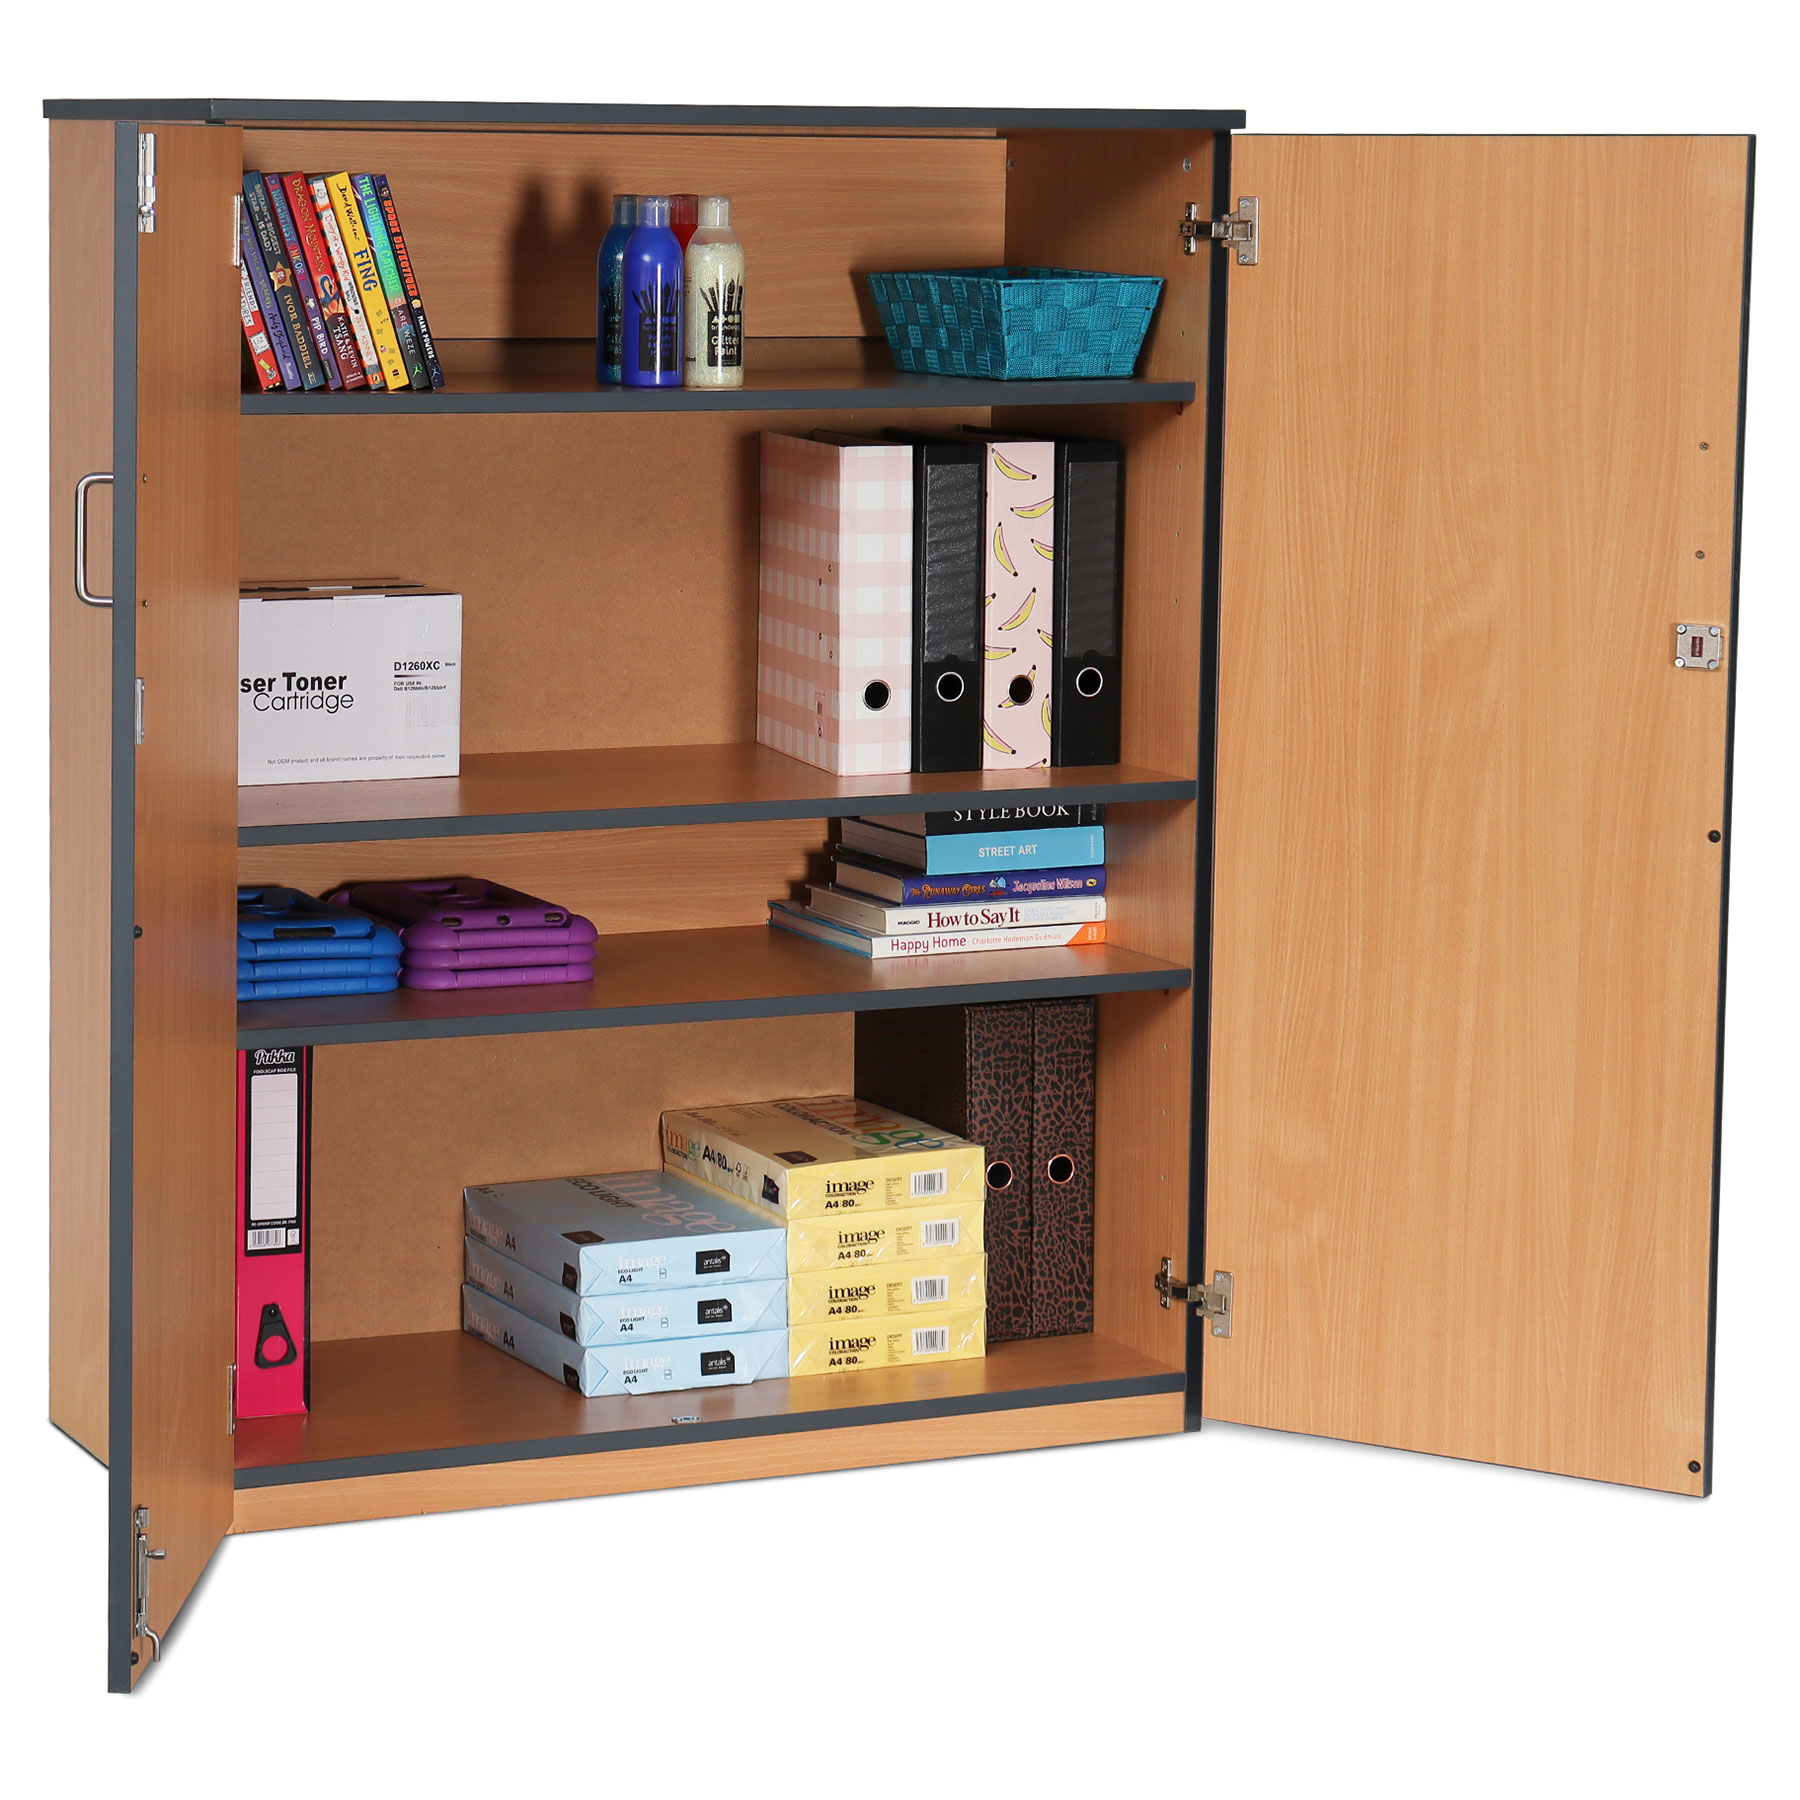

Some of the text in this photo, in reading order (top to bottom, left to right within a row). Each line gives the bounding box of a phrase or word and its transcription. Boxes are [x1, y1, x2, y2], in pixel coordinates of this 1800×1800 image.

[248, 192, 261, 213] STAR
[271, 188, 296, 242] NAUGHTIEST
[292, 176, 326, 272] DRAGON MOUNTAIN
[324, 213, 337, 236] Diary
[257, 221, 266, 230] IS
[358, 175, 401, 293] THE LIGHTNING CATCHER
[260, 230, 273, 252] DAD?
[266, 221, 282, 255] BIGGEST
[383, 199, 419, 297] SPACE DETECTIVES
[353, 247, 379, 293] FING
[242, 277, 257, 311] FRIENDS
[241, 295, 252, 325] ATURES
[284, 293, 298, 322] IVOR
[292, 322, 314, 369] BADDIEL
[310, 316, 330, 355] PIP BIRD
[394, 297, 417, 356] CLARE WEZE
[333, 327, 350, 361] TSANG
[337, 315, 351, 339] KATIE
[346, 345, 359, 369] KEVIN
[416, 315, 435, 360] MARK POWERS
[361, 334, 376, 363] KINNEY
[394, 661, 441, 671] D1260XC
[240, 672, 347, 693] ser Toner
[253, 691, 355, 714] Cartridge
[290, 758, 309, 766] product
[367, 755, 387, 763] property
[953, 806, 1011, 822] STYLE
[1015, 803, 1070, 818] BOOK
[978, 844, 1038, 858] STREET ART
[1012, 879, 1055, 895] Jacqueline
[1056, 877, 1083, 890] Wilson
[926, 912, 962, 928] How
[964, 911, 979, 925] to
[980, 908, 1007, 928] Say
[1007, 906, 1021, 922] It
[890, 938, 929, 954] Happy
[932, 936, 966, 949] Home
[971, 936, 1002, 946] Charlotte
[1003, 934, 1034, 944] Hedeman
[254, 1049, 295, 1066] Pukka
[771, 1101, 854, 1137] COLORACTION
[798, 1097, 944, 1151] image
[664, 1126, 702, 1162] image
[826, 1180, 875, 1196] image
[597, 1174, 736, 1234] image
[825, 1200, 839, 1209] A4
[842, 1199, 855, 1208] 80
[505, 1232, 516, 1252] A4
[838, 1229, 886, 1246] image
[619, 1255, 722, 1270] image antalis
[838, 1251, 851, 1260] A4
[854, 1249, 867, 1258] 80
[618, 1274, 632, 1284] A4
[503, 1280, 514, 1300] A4
[828, 1284, 877, 1301] image
[621, 1304, 723, 1319] image antalis
[828, 1307, 842, 1315] A4
[845, 1305, 858, 1314] 80
[619, 1324, 634, 1333] A4
[503, 1330, 515, 1350] A4
[829, 1336, 877, 1352] image
[625, 1355, 727, 1371] image antalis
[829, 1358, 842, 1367] A4
[845, 1356, 858, 1365] 80
[624, 1376, 638, 1385] A4
